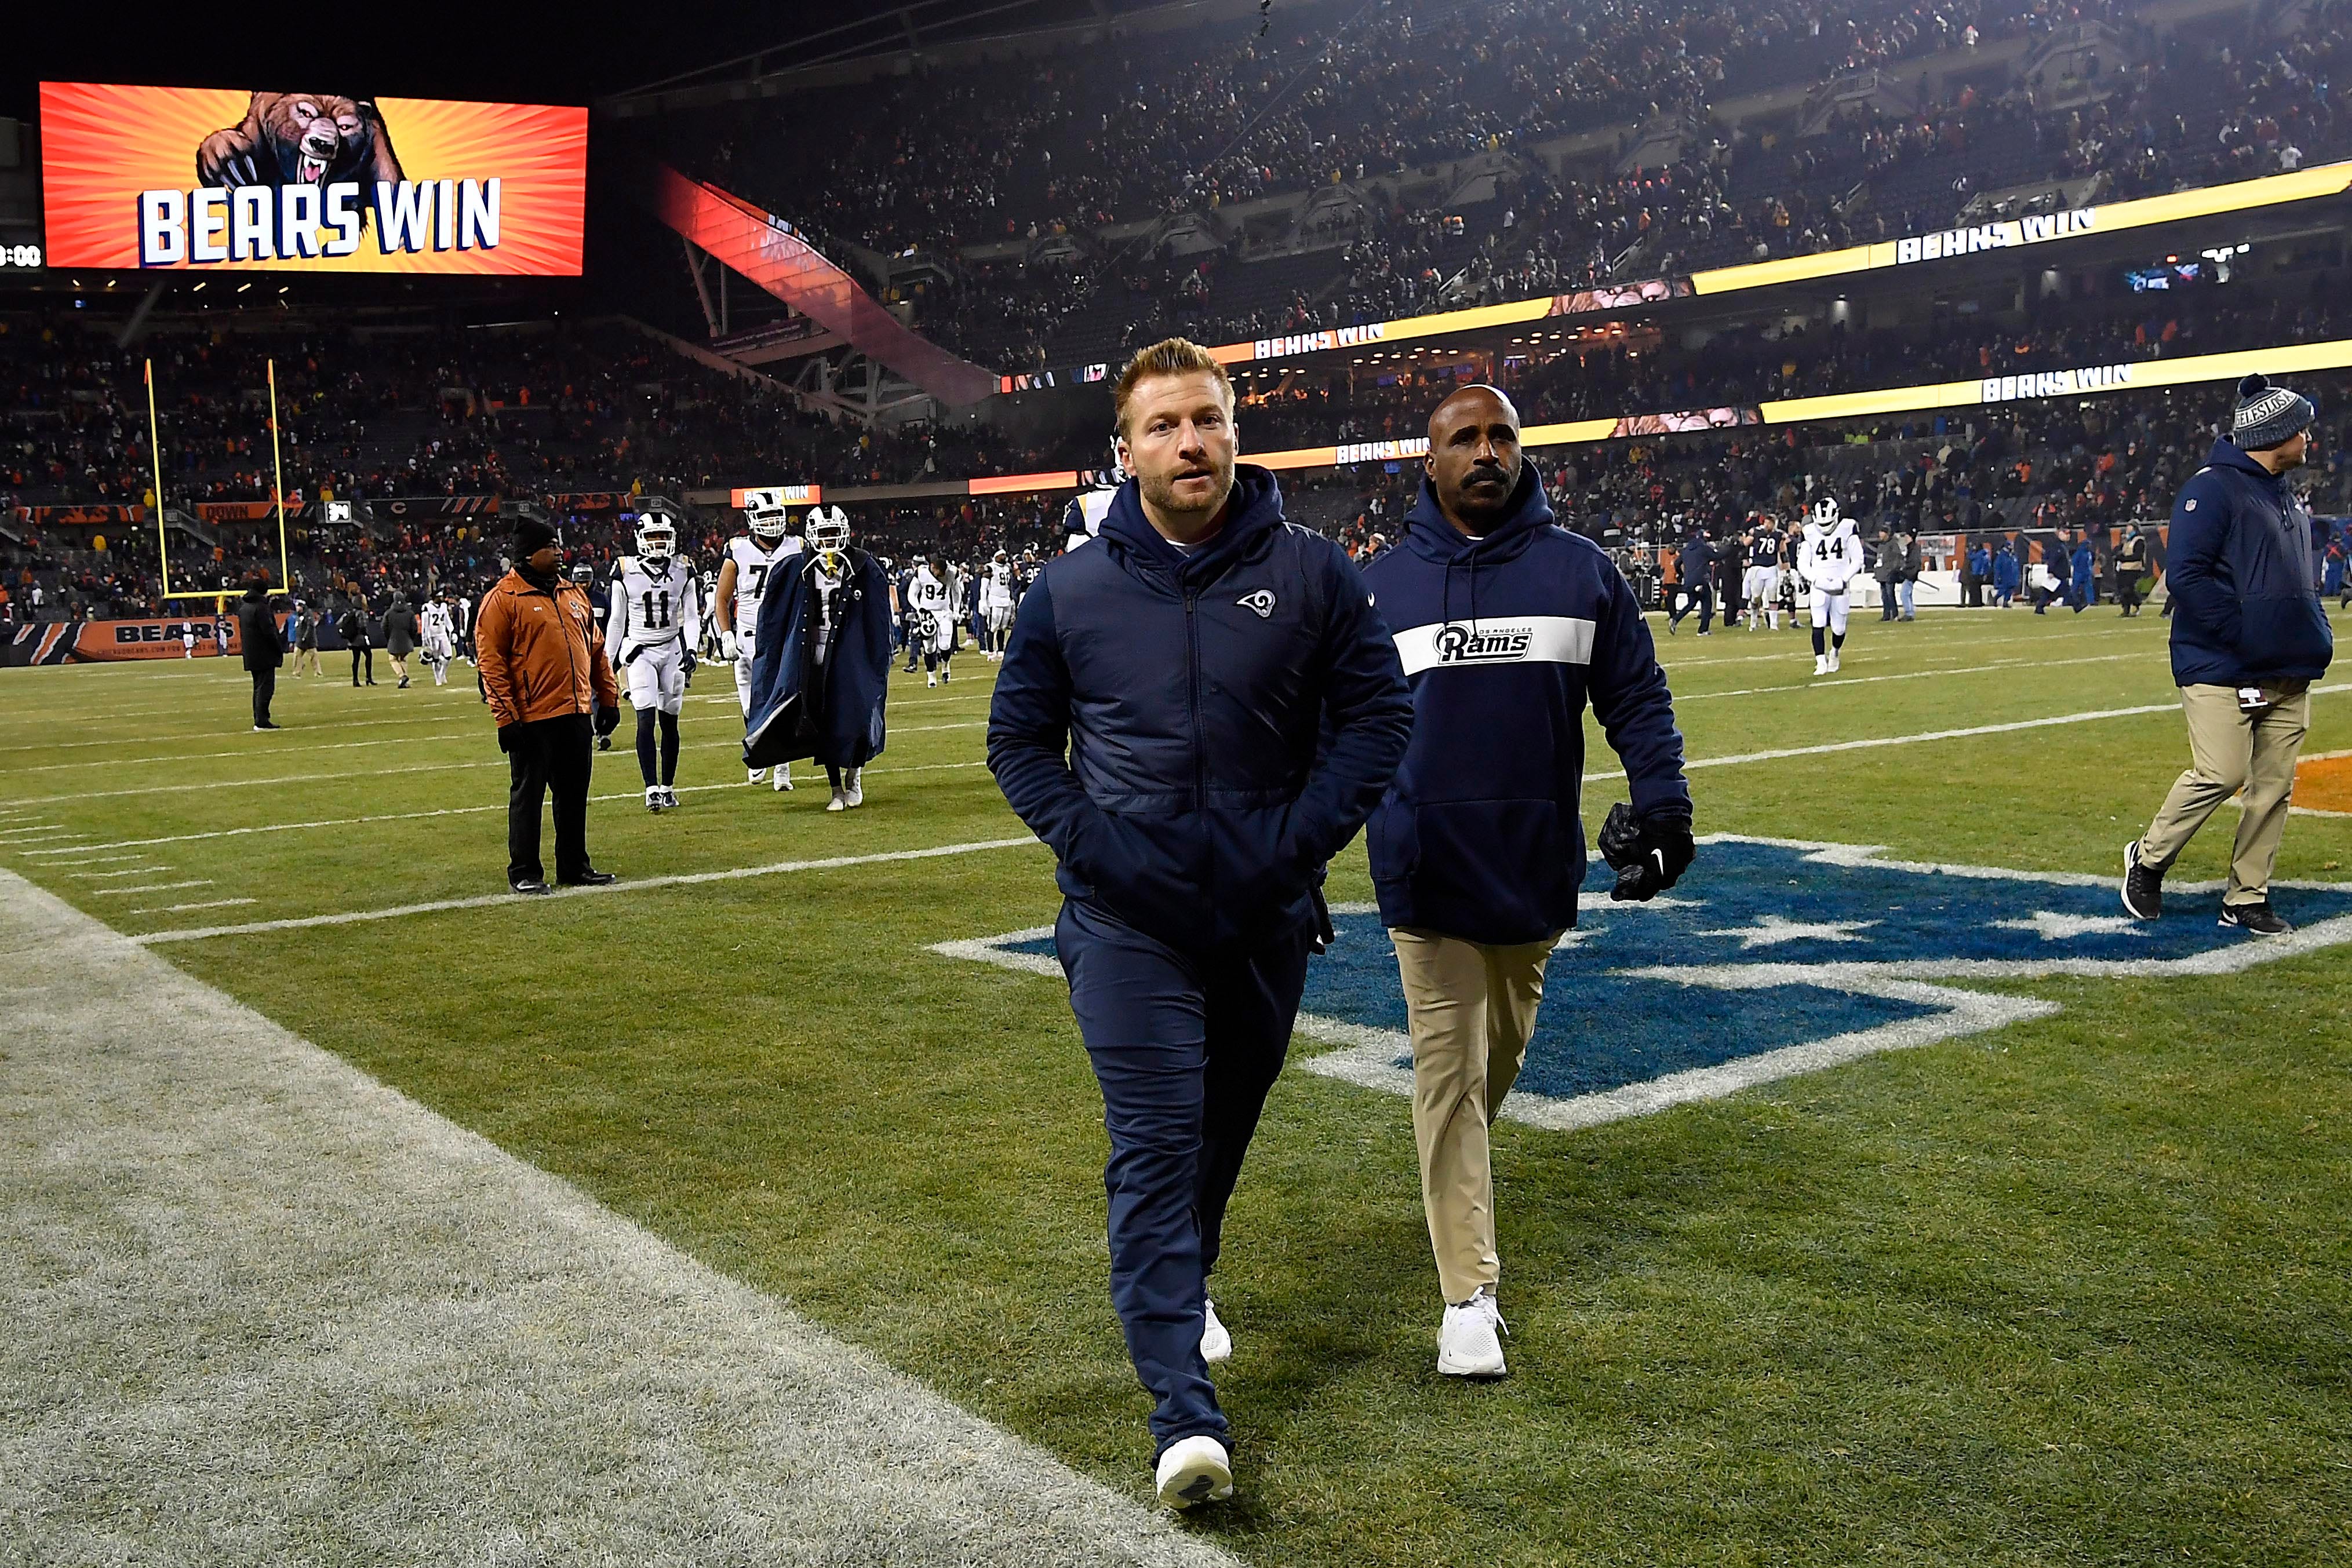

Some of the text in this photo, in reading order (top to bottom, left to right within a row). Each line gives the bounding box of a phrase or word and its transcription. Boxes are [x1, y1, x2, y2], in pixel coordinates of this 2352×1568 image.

[138, 177, 500, 265] BEARS WIN
[2022, 207, 2095, 241] WIN
[1337, 323, 1384, 345] WIN
[2077, 363, 2133, 389] WIN
[784, 485, 809, 500] WIN
[1758, 537, 1776, 555] 78
[1815, 537, 1843, 560] 44
[749, 565, 769, 599] 7
[925, 584, 946, 600] 94
[642, 590, 671, 629] 11
[1434, 625, 1530, 662] Rams
